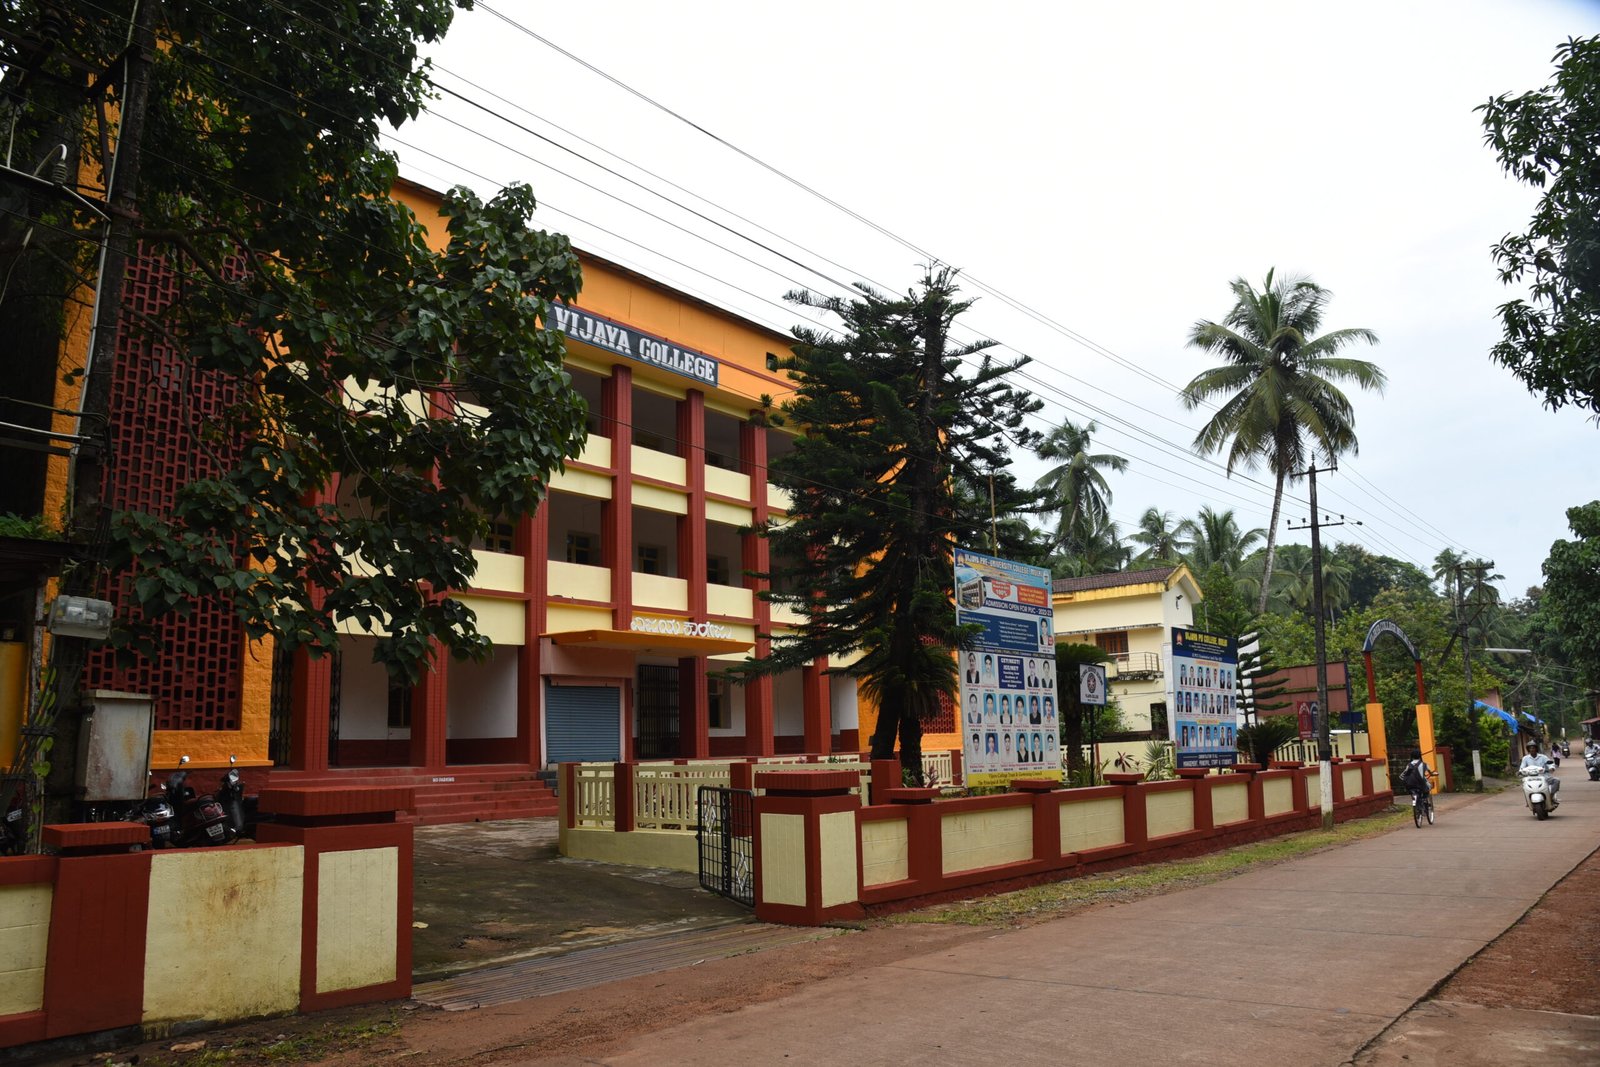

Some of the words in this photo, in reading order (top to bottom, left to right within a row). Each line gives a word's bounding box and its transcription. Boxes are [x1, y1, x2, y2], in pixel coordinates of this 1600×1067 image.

[554, 306, 632, 355] VIJAYA
[639, 337, 715, 382] COLLEGE
[986, 599, 1008, 610] ADMISSION
